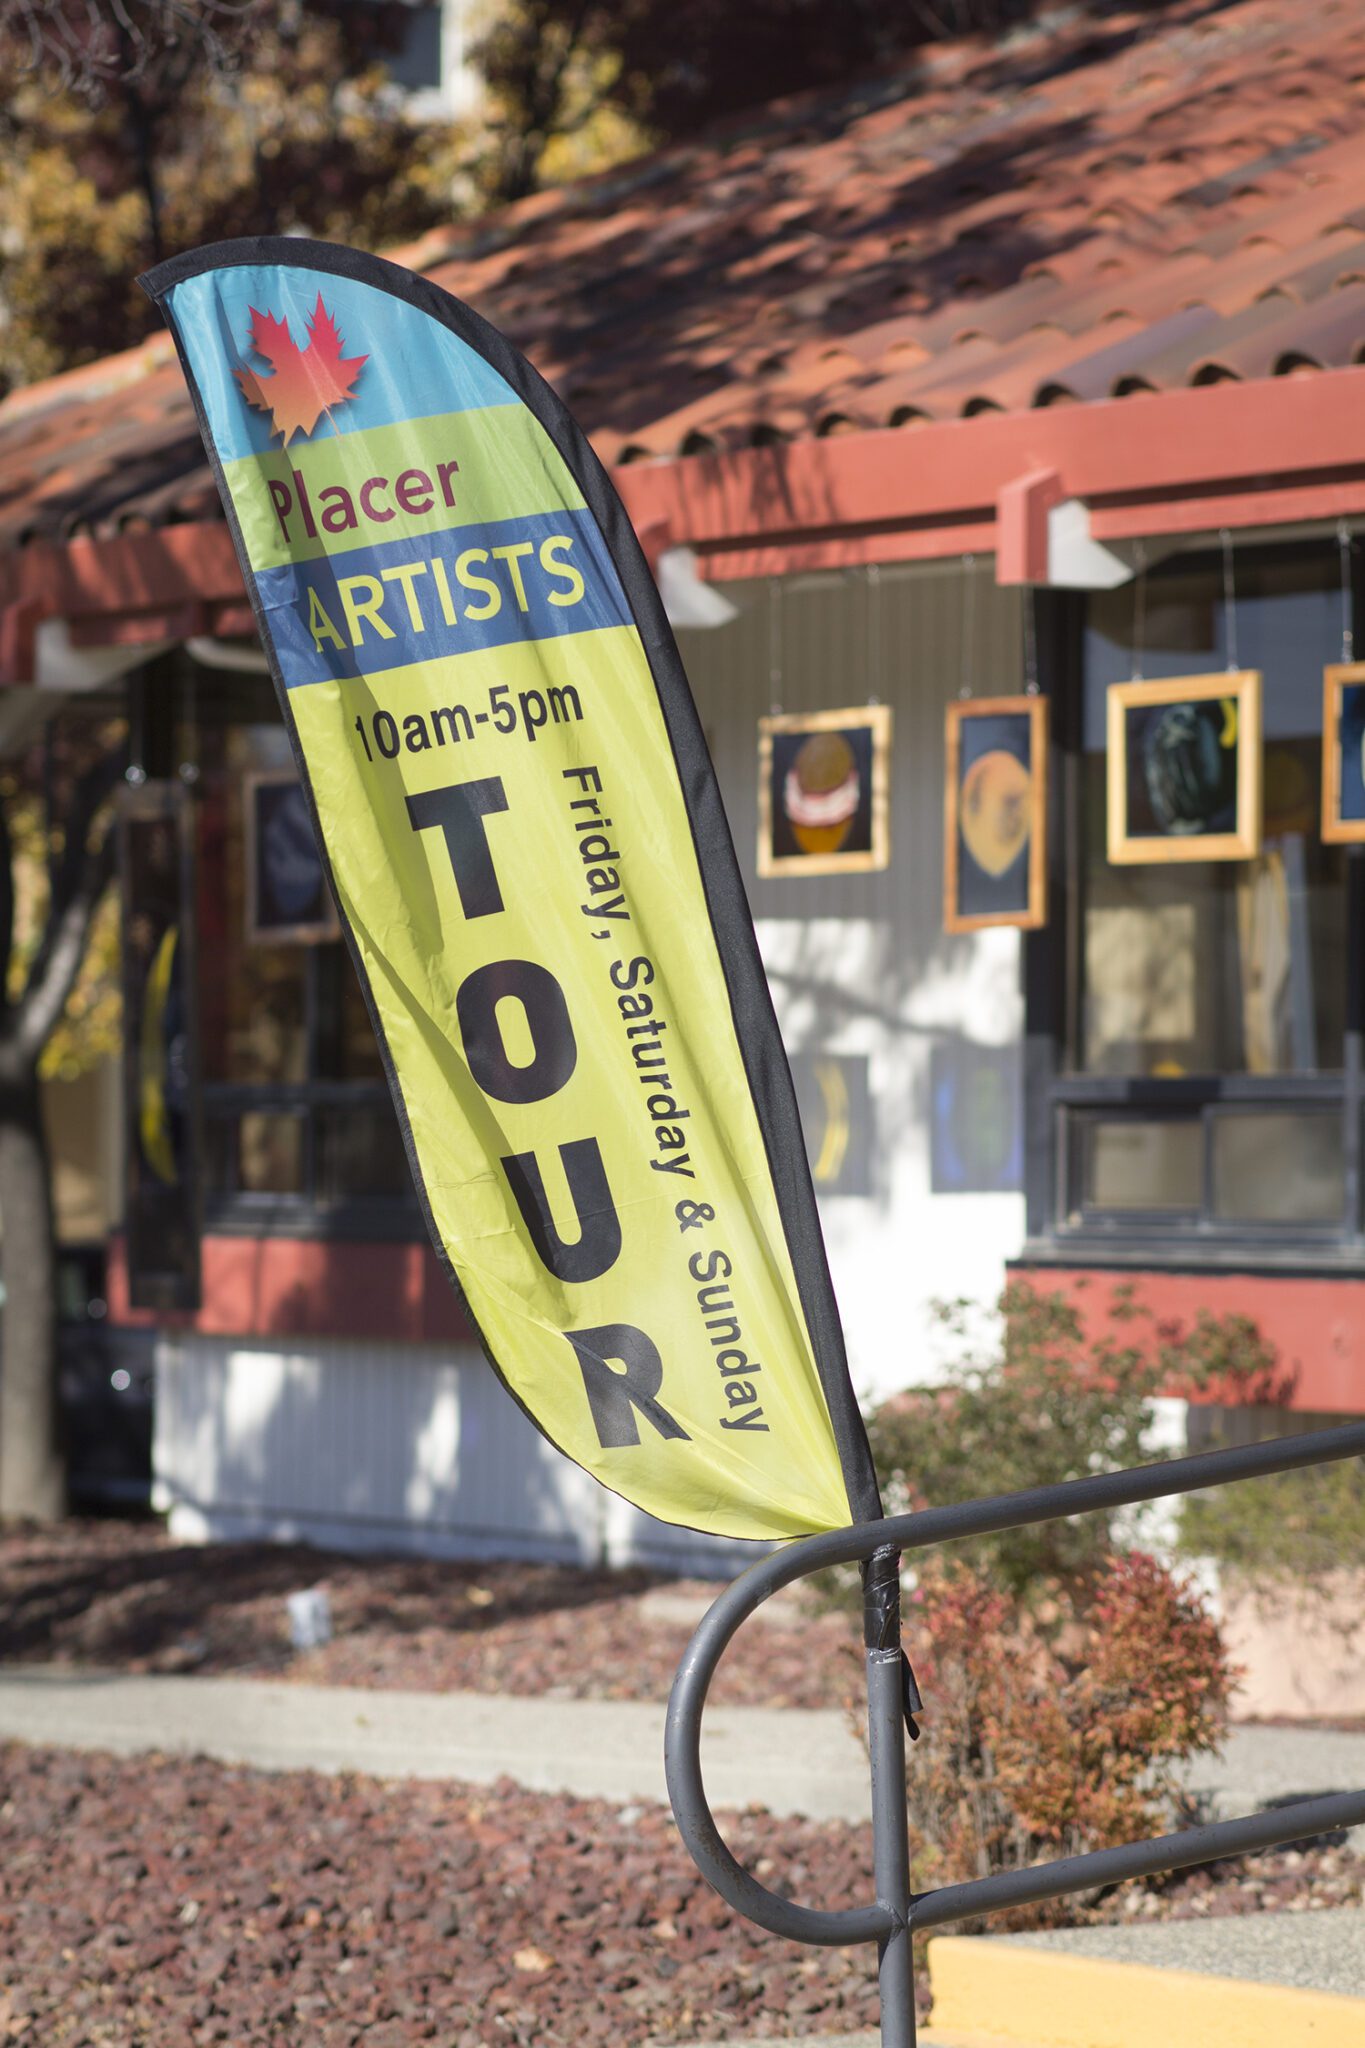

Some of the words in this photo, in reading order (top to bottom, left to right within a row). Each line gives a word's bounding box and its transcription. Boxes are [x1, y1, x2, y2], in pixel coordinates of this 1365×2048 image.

[266, 459, 460, 543] Placer
[307, 535, 586, 653] ARTISTS
[355, 682, 584, 762] 10am-5pm
[562, 765, 631, 939] Friday,
[404, 775, 693, 1448] TOUR
[609, 956, 696, 1178] Saturday
[674, 1199, 716, 1233] &
[688, 1249, 770, 1432] Sunday
